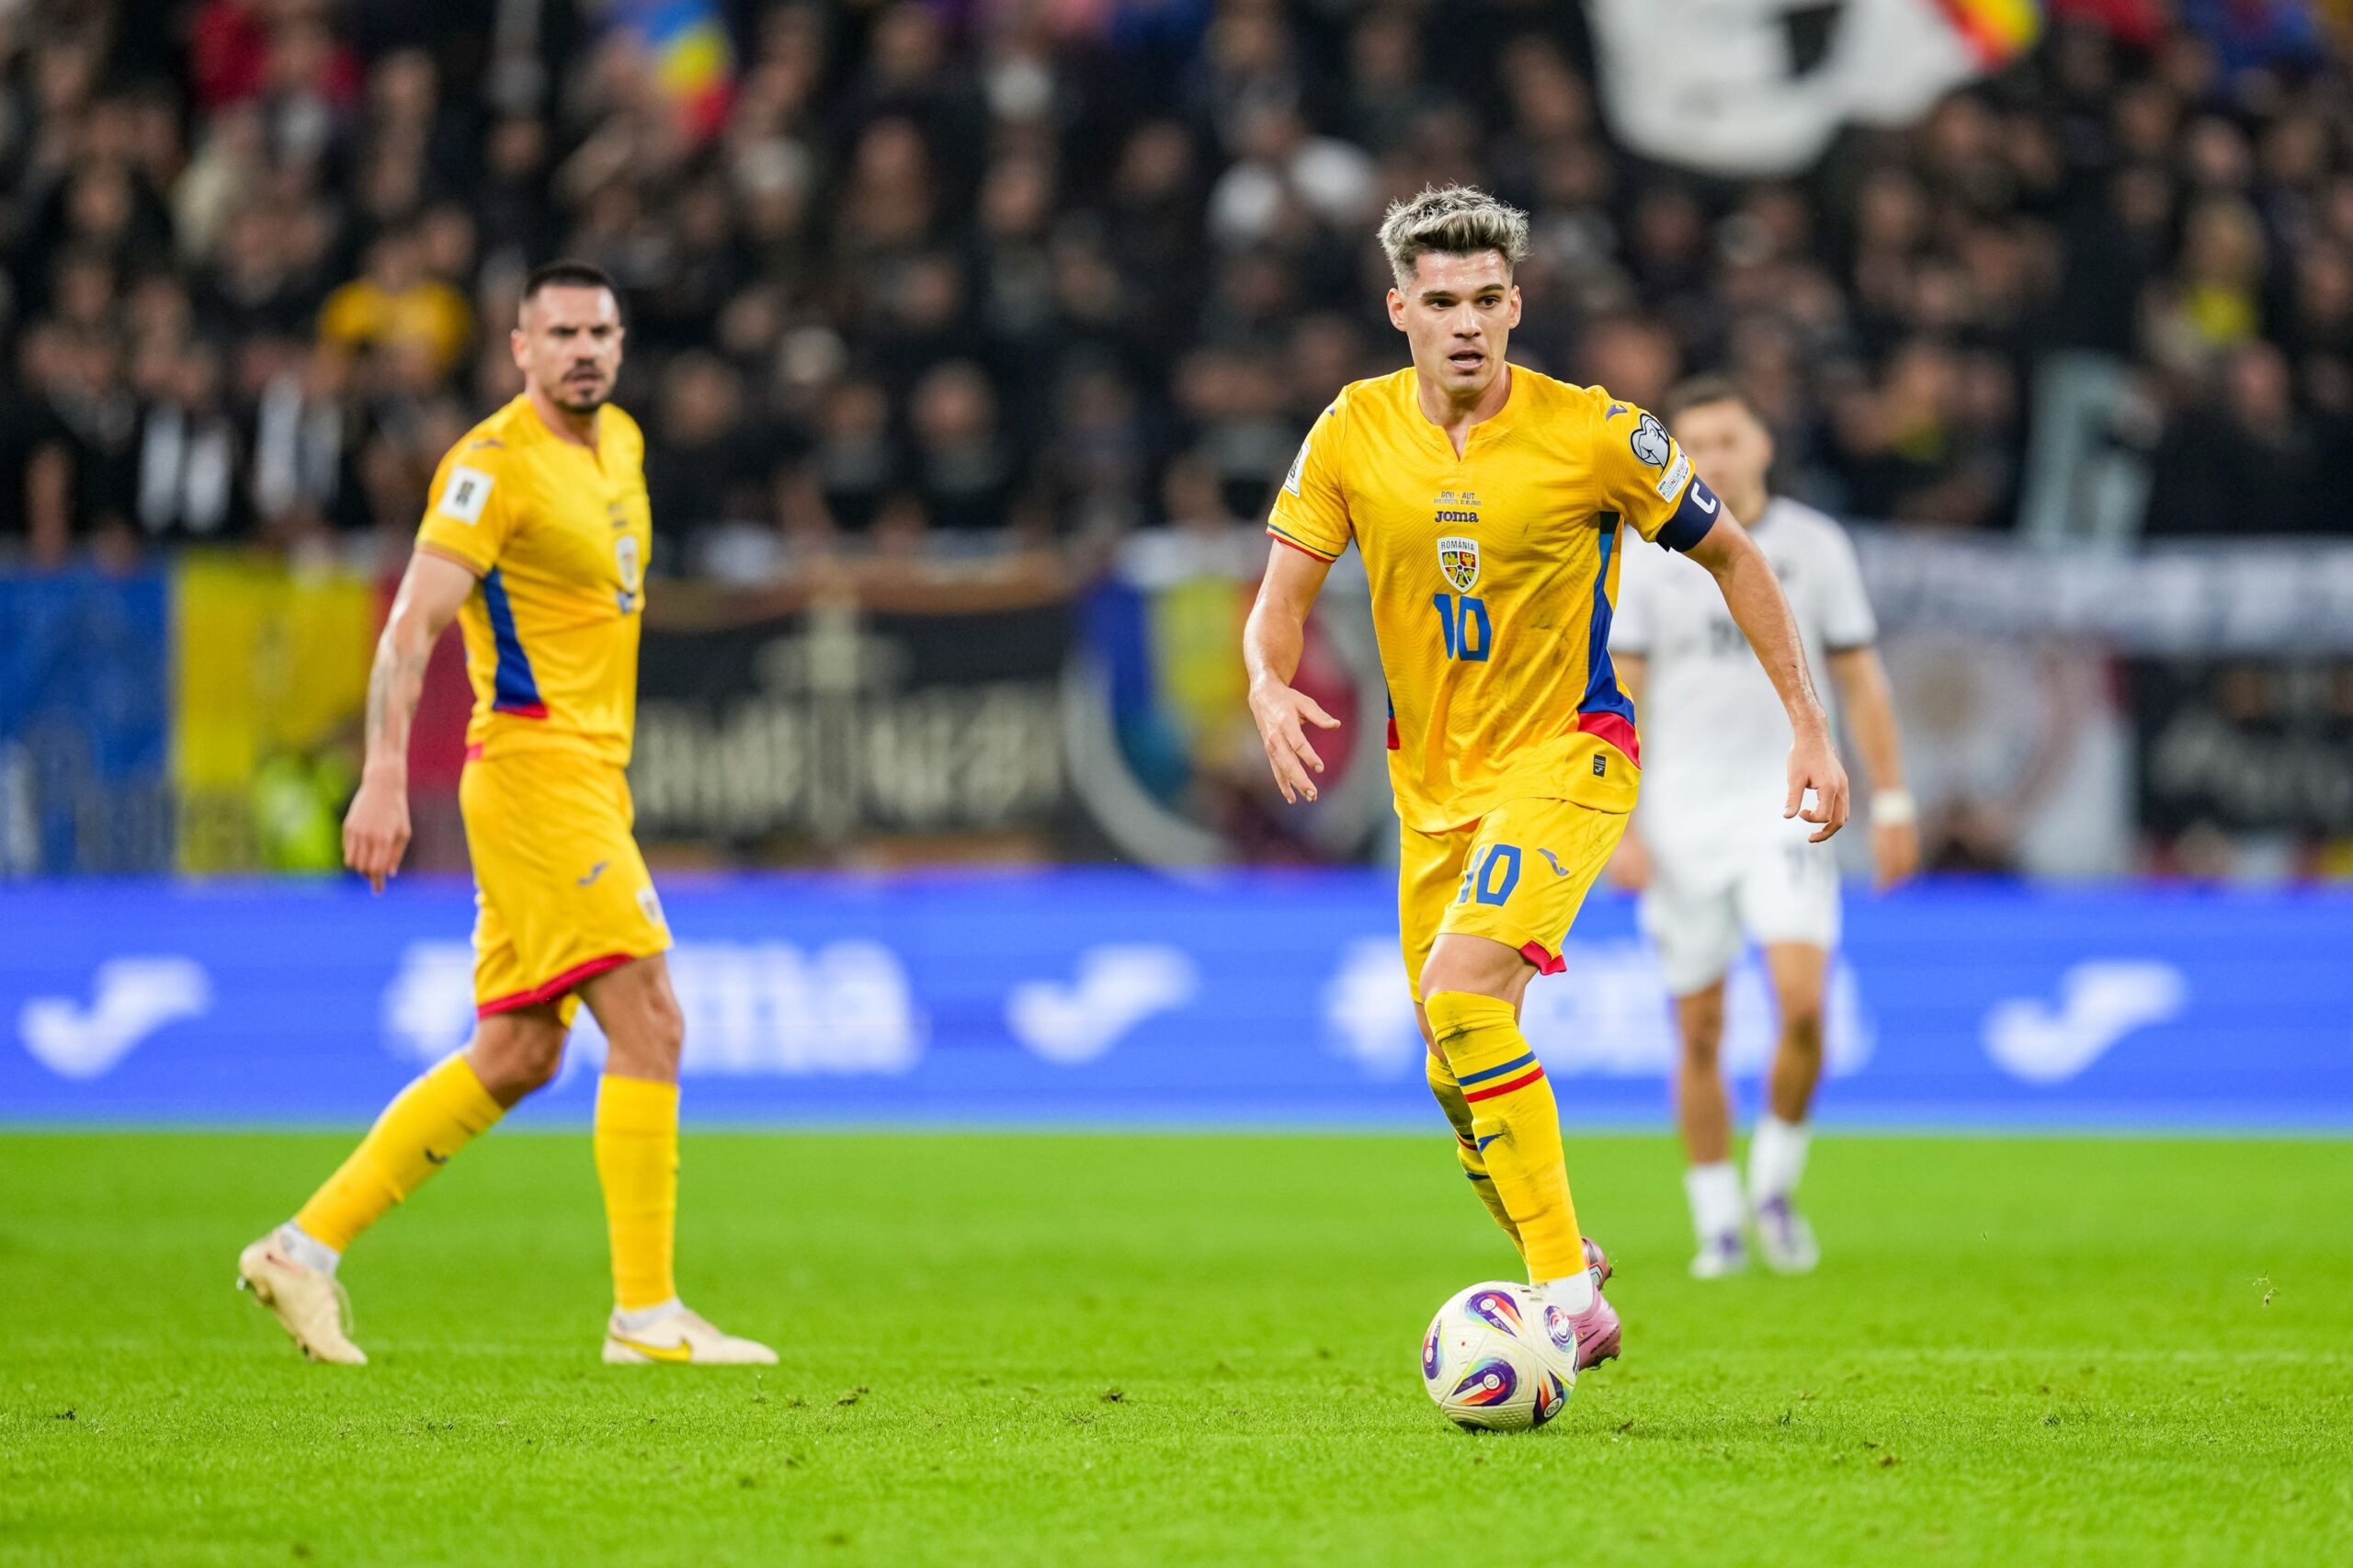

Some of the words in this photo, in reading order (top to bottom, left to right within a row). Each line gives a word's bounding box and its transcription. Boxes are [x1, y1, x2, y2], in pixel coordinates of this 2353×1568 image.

[1441, 491, 1455, 499] ROU
[1662, 459, 1687, 498] FOUNATIO
[1690, 482, 1717, 515] C
[1440, 539, 1475, 551] ROMÂNIA
[1433, 593, 1492, 662] 10
